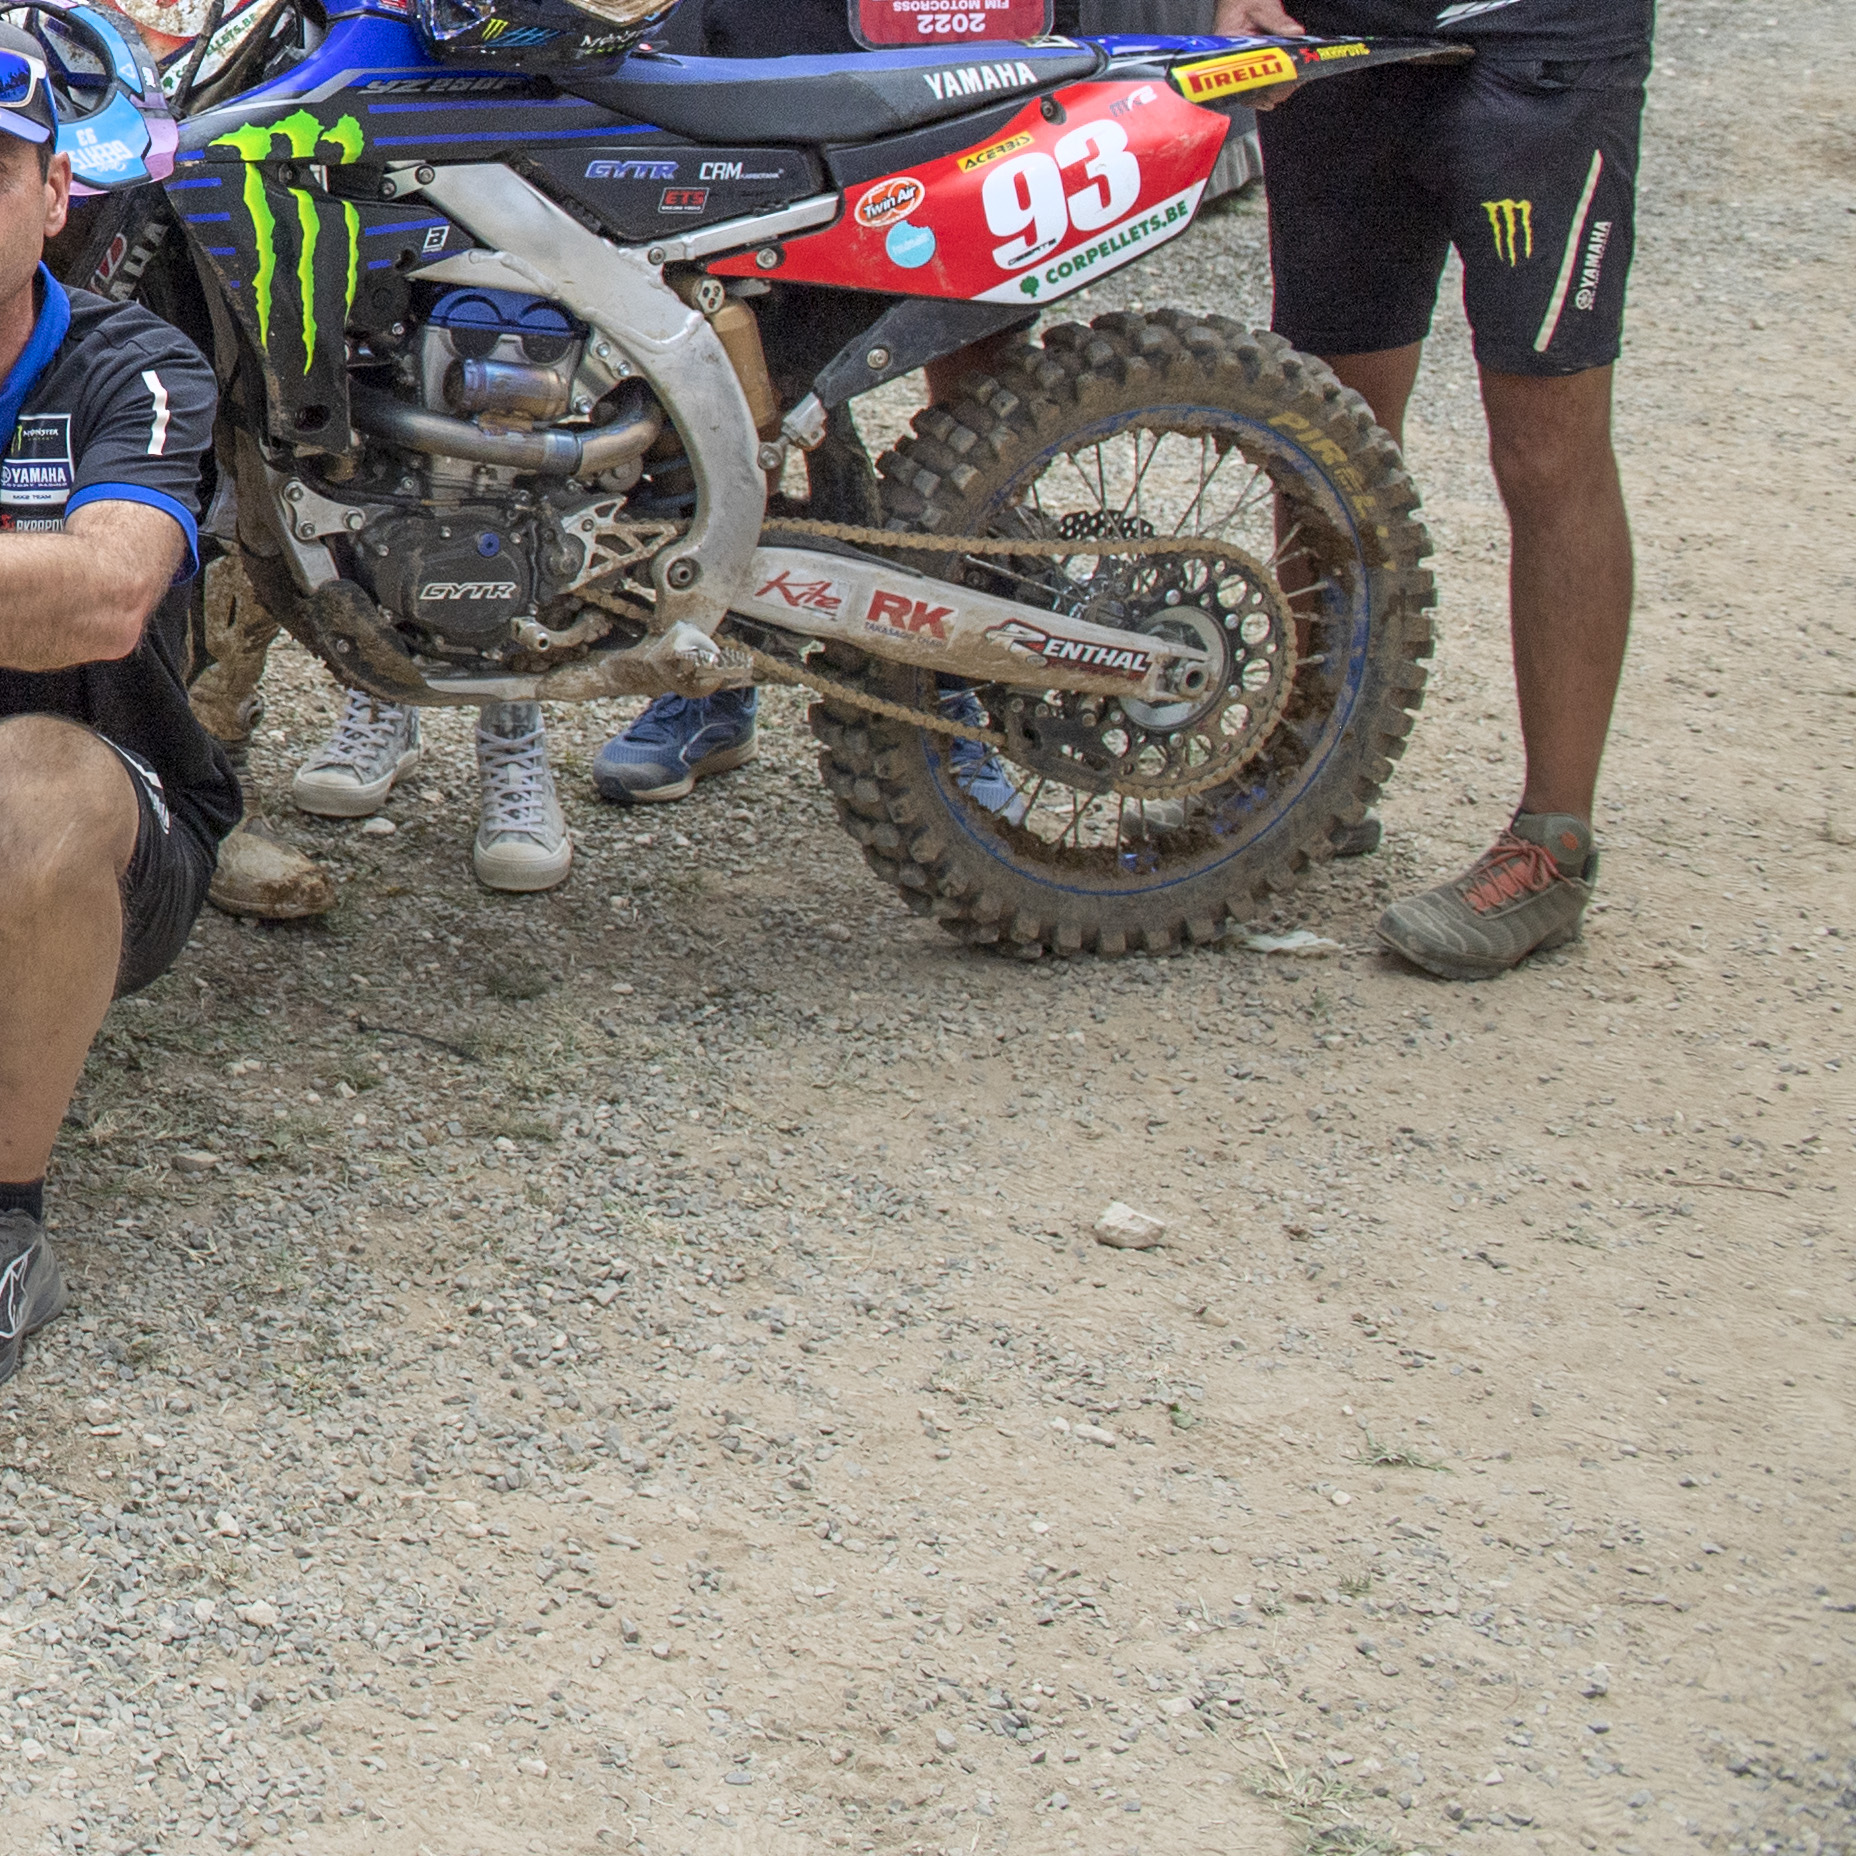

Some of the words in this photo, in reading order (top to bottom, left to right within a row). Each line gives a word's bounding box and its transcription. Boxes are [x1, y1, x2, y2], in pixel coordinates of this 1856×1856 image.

[893, 0, 980, 11] MOTOCROSS
[984, 0, 1008, 9] FIM
[917, 14, 985, 33] 2022
[924, 61, 1038, 101] YAMAHA
[1190, 53, 1283, 94] PIRELLI
[964, 131, 1030, 168] ACERBIS
[585, 160, 679, 179] GYTR
[700, 162, 742, 180] CRM
[863, 200, 896, 218] Twin
[896, 185, 916, 205] Air
[982, 119, 1142, 270] 93
[1045, 199, 1189, 285] CORPELLETS.BE
[1582, 220, 1611, 290] YAMAHA
[12, 468, 66, 483] YAMAHA
[419, 582, 517, 600] GYTR
[756, 571, 842, 616] Kite
[866, 589, 957, 639] RK
